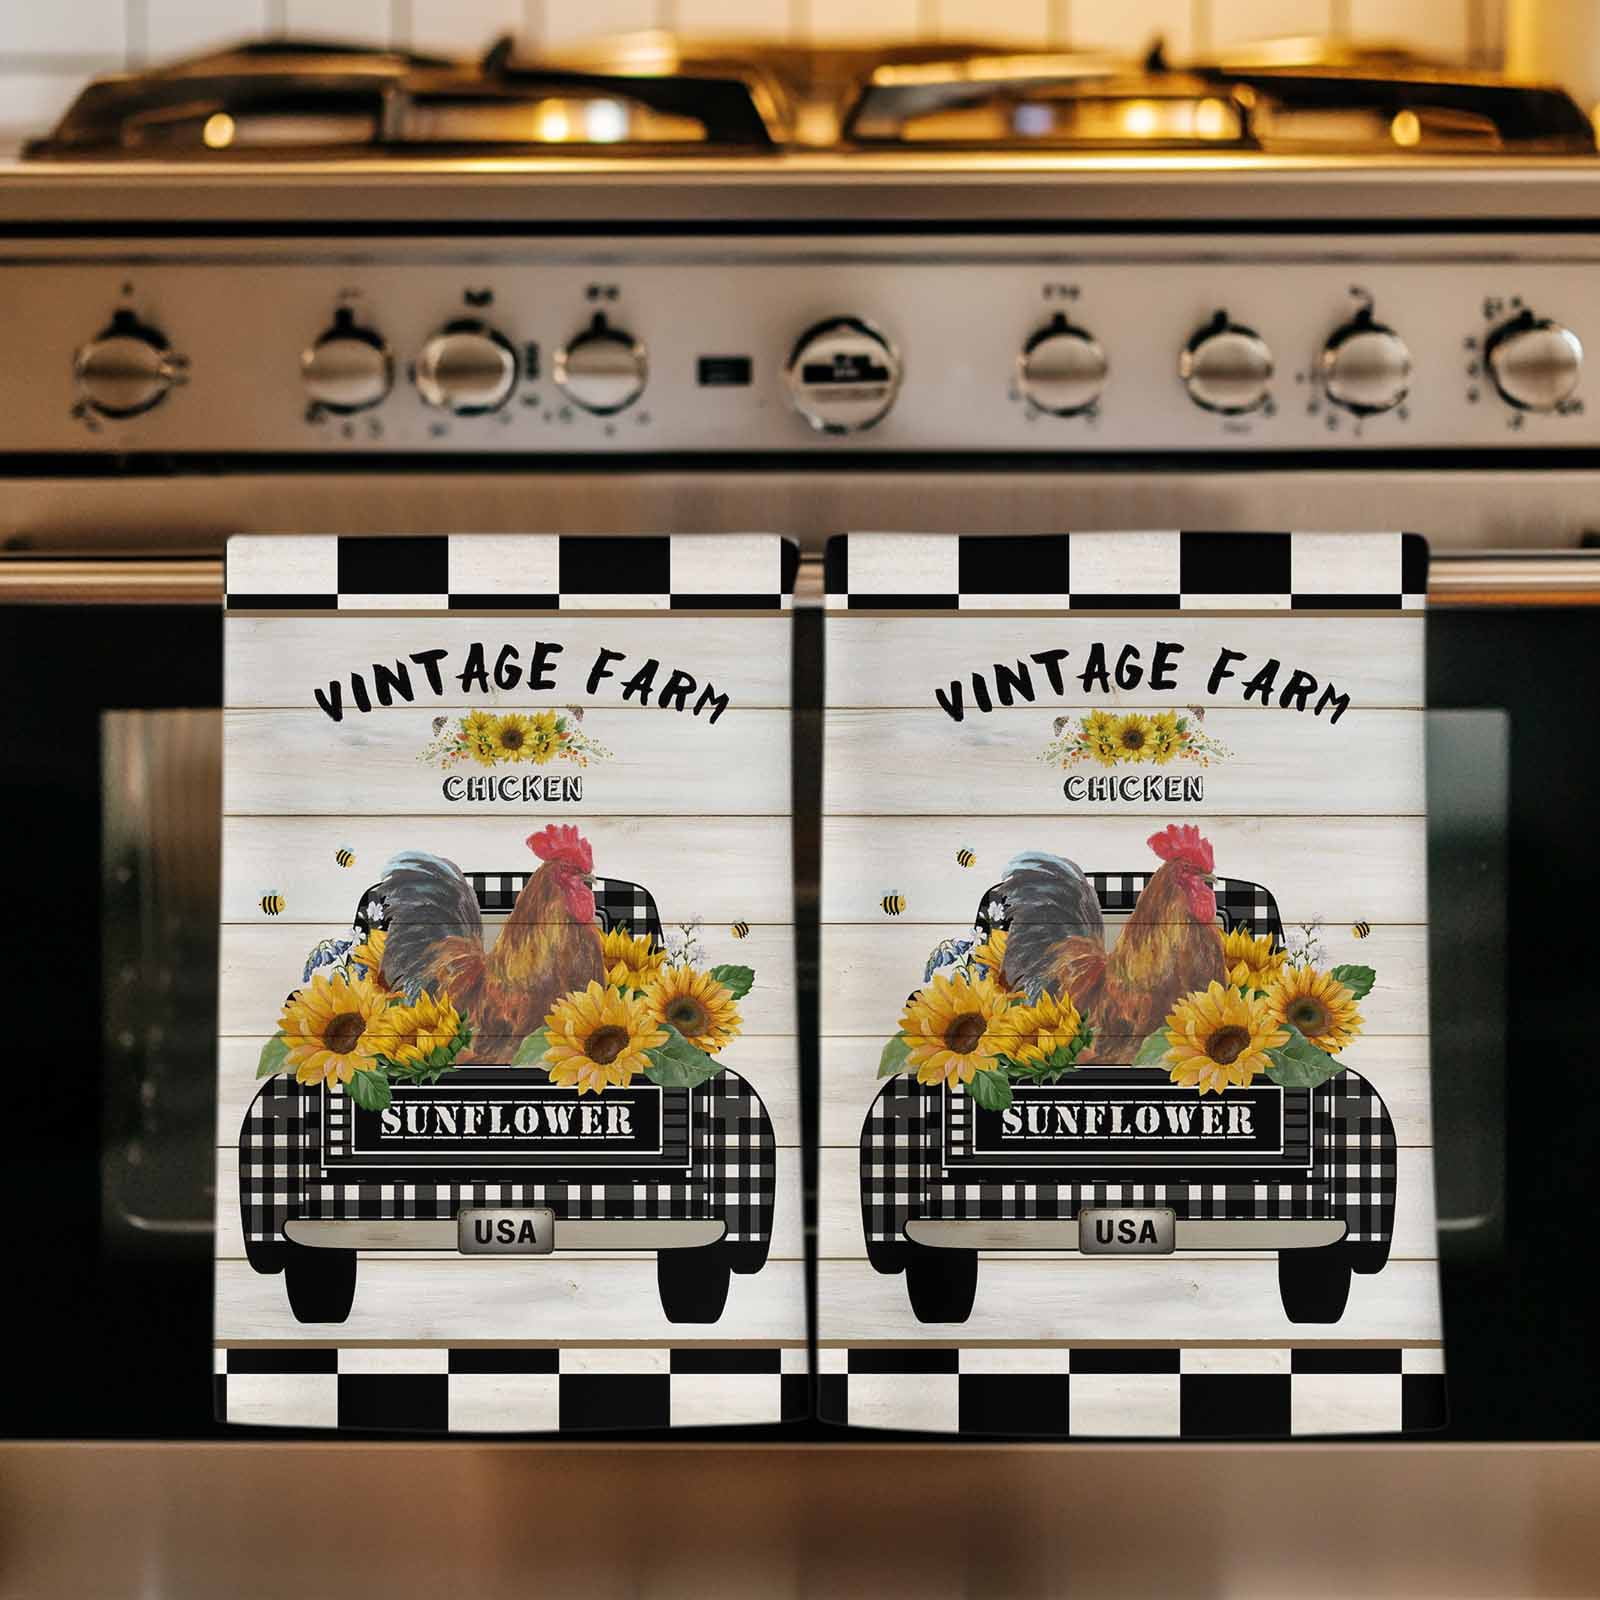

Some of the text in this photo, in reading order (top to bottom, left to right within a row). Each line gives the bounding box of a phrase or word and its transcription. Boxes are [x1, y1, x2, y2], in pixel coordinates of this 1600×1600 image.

[314, 642, 730, 724] VINTAGE FARM
[935, 642, 1351, 724] VINTAGE FARM
[442, 776, 583, 802] CHICKEN
[1063, 776, 1204, 802] CHICKEN
[381, 1104, 634, 1137] SUNFLOWER
[1002, 1104, 1255, 1137] SUNFLOWER
[475, 1219, 537, 1244] USA
[1096, 1219, 1158, 1244] USA
